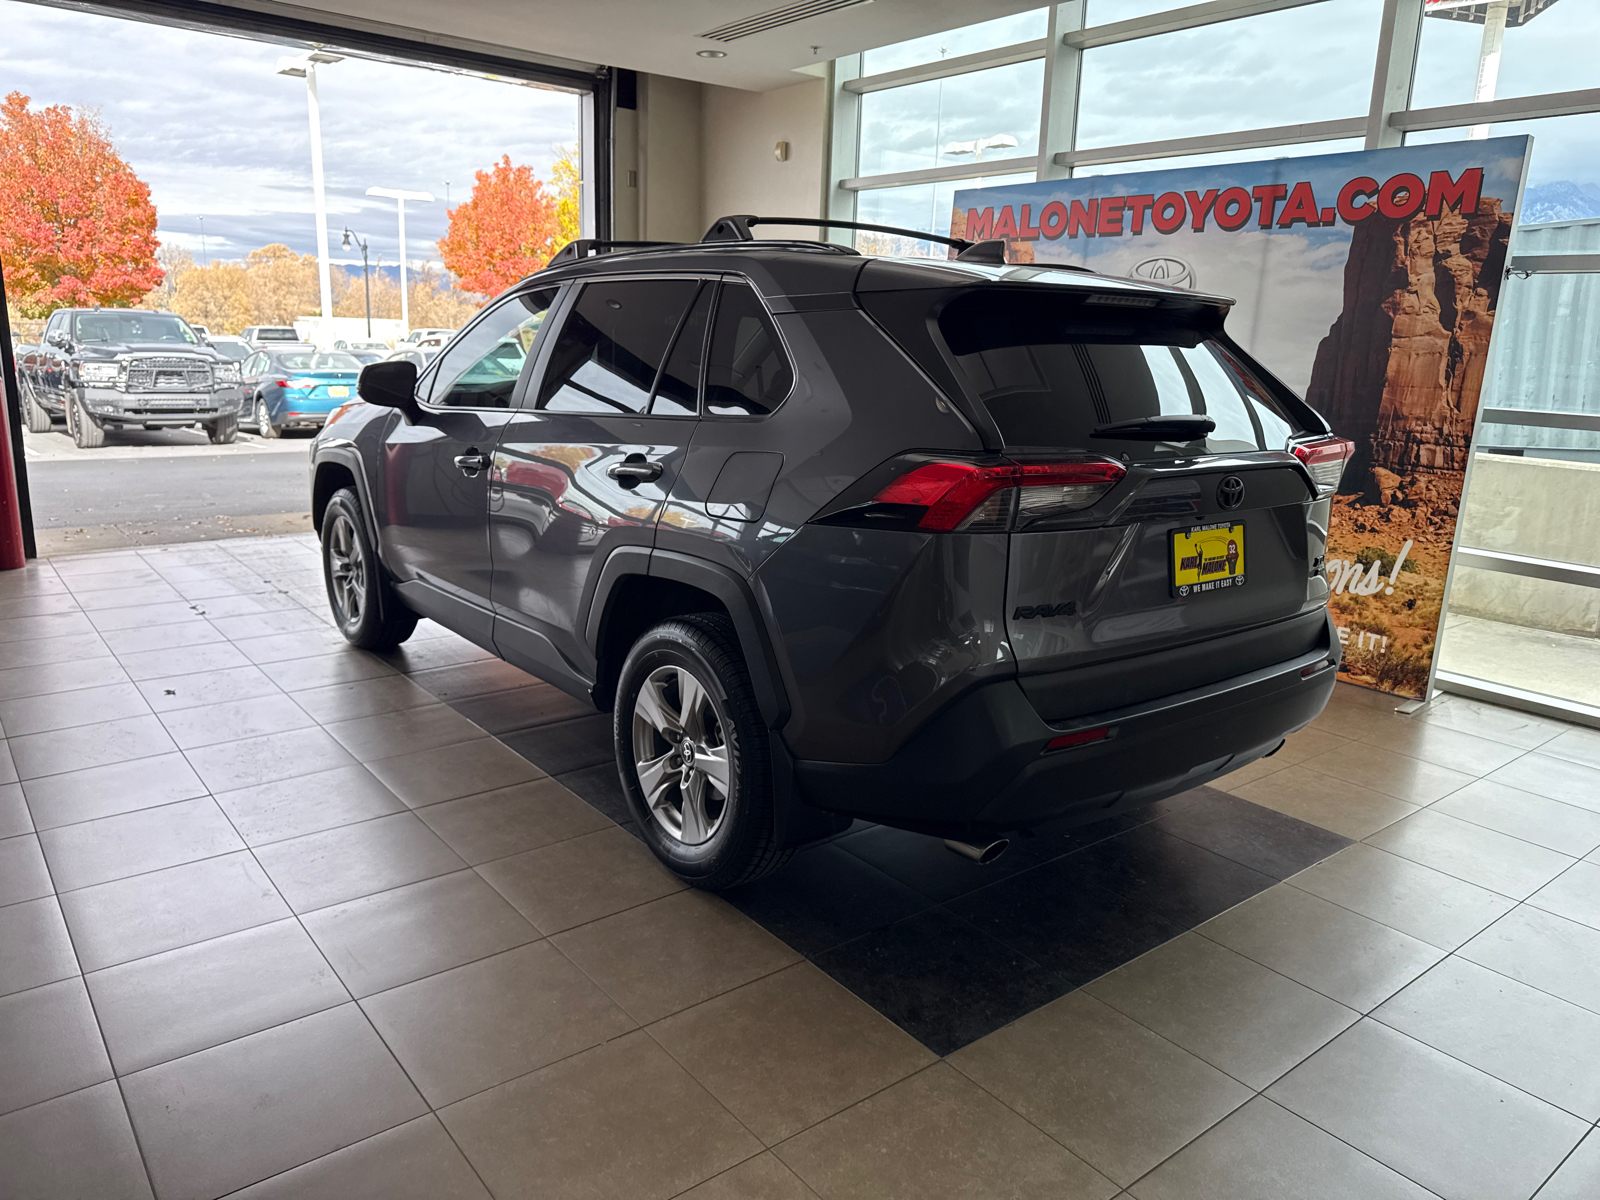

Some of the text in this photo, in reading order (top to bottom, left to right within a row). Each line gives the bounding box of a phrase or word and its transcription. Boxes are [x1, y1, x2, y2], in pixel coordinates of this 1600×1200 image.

[966, 167, 1484, 242] MALONETOYOTA.COM
[1202, 523, 1217, 531] MALONE
[1229, 544, 1236, 553] 32
[1180, 556, 1227, 576] KARL MALONE
[1325, 539, 1414, 596] ons!
[1193, 578, 1232, 593] WE MAKE IT EASY
[1012, 600, 1077, 620] RAV4
[1358, 631, 1388, 654] IT!
